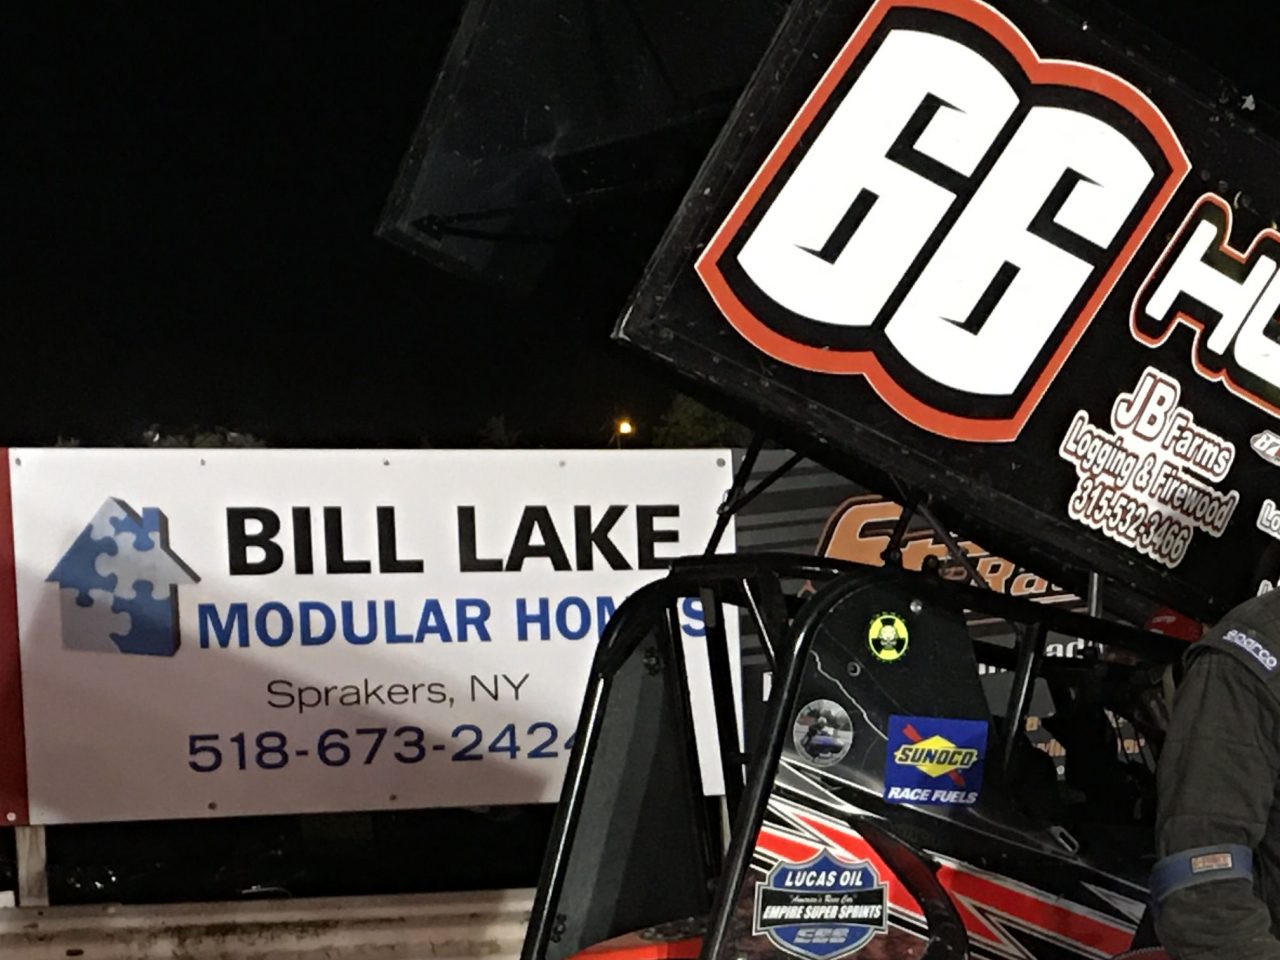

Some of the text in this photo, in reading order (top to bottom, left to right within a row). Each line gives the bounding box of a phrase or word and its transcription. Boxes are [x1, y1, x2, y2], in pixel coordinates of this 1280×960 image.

[737, 29, 1154, 394] 66
[1114, 371, 1232, 476] JB Farms
[1065, 414, 1235, 530] Logging & Firewood
[226, 504, 681, 576] BILL LAKE
[200, 597, 492, 649] MODULAR
[1222, 629, 1278, 670] sparco
[267, 674, 530, 714] Sprakers, NY
[898, 746, 975, 767] SUNOCO
[888, 786, 978, 804] RACE FUELS
[784, 870, 864, 886] LUCAS OIL
[762, 904, 882, 919] EMPIRE SUPER SPRINTS
